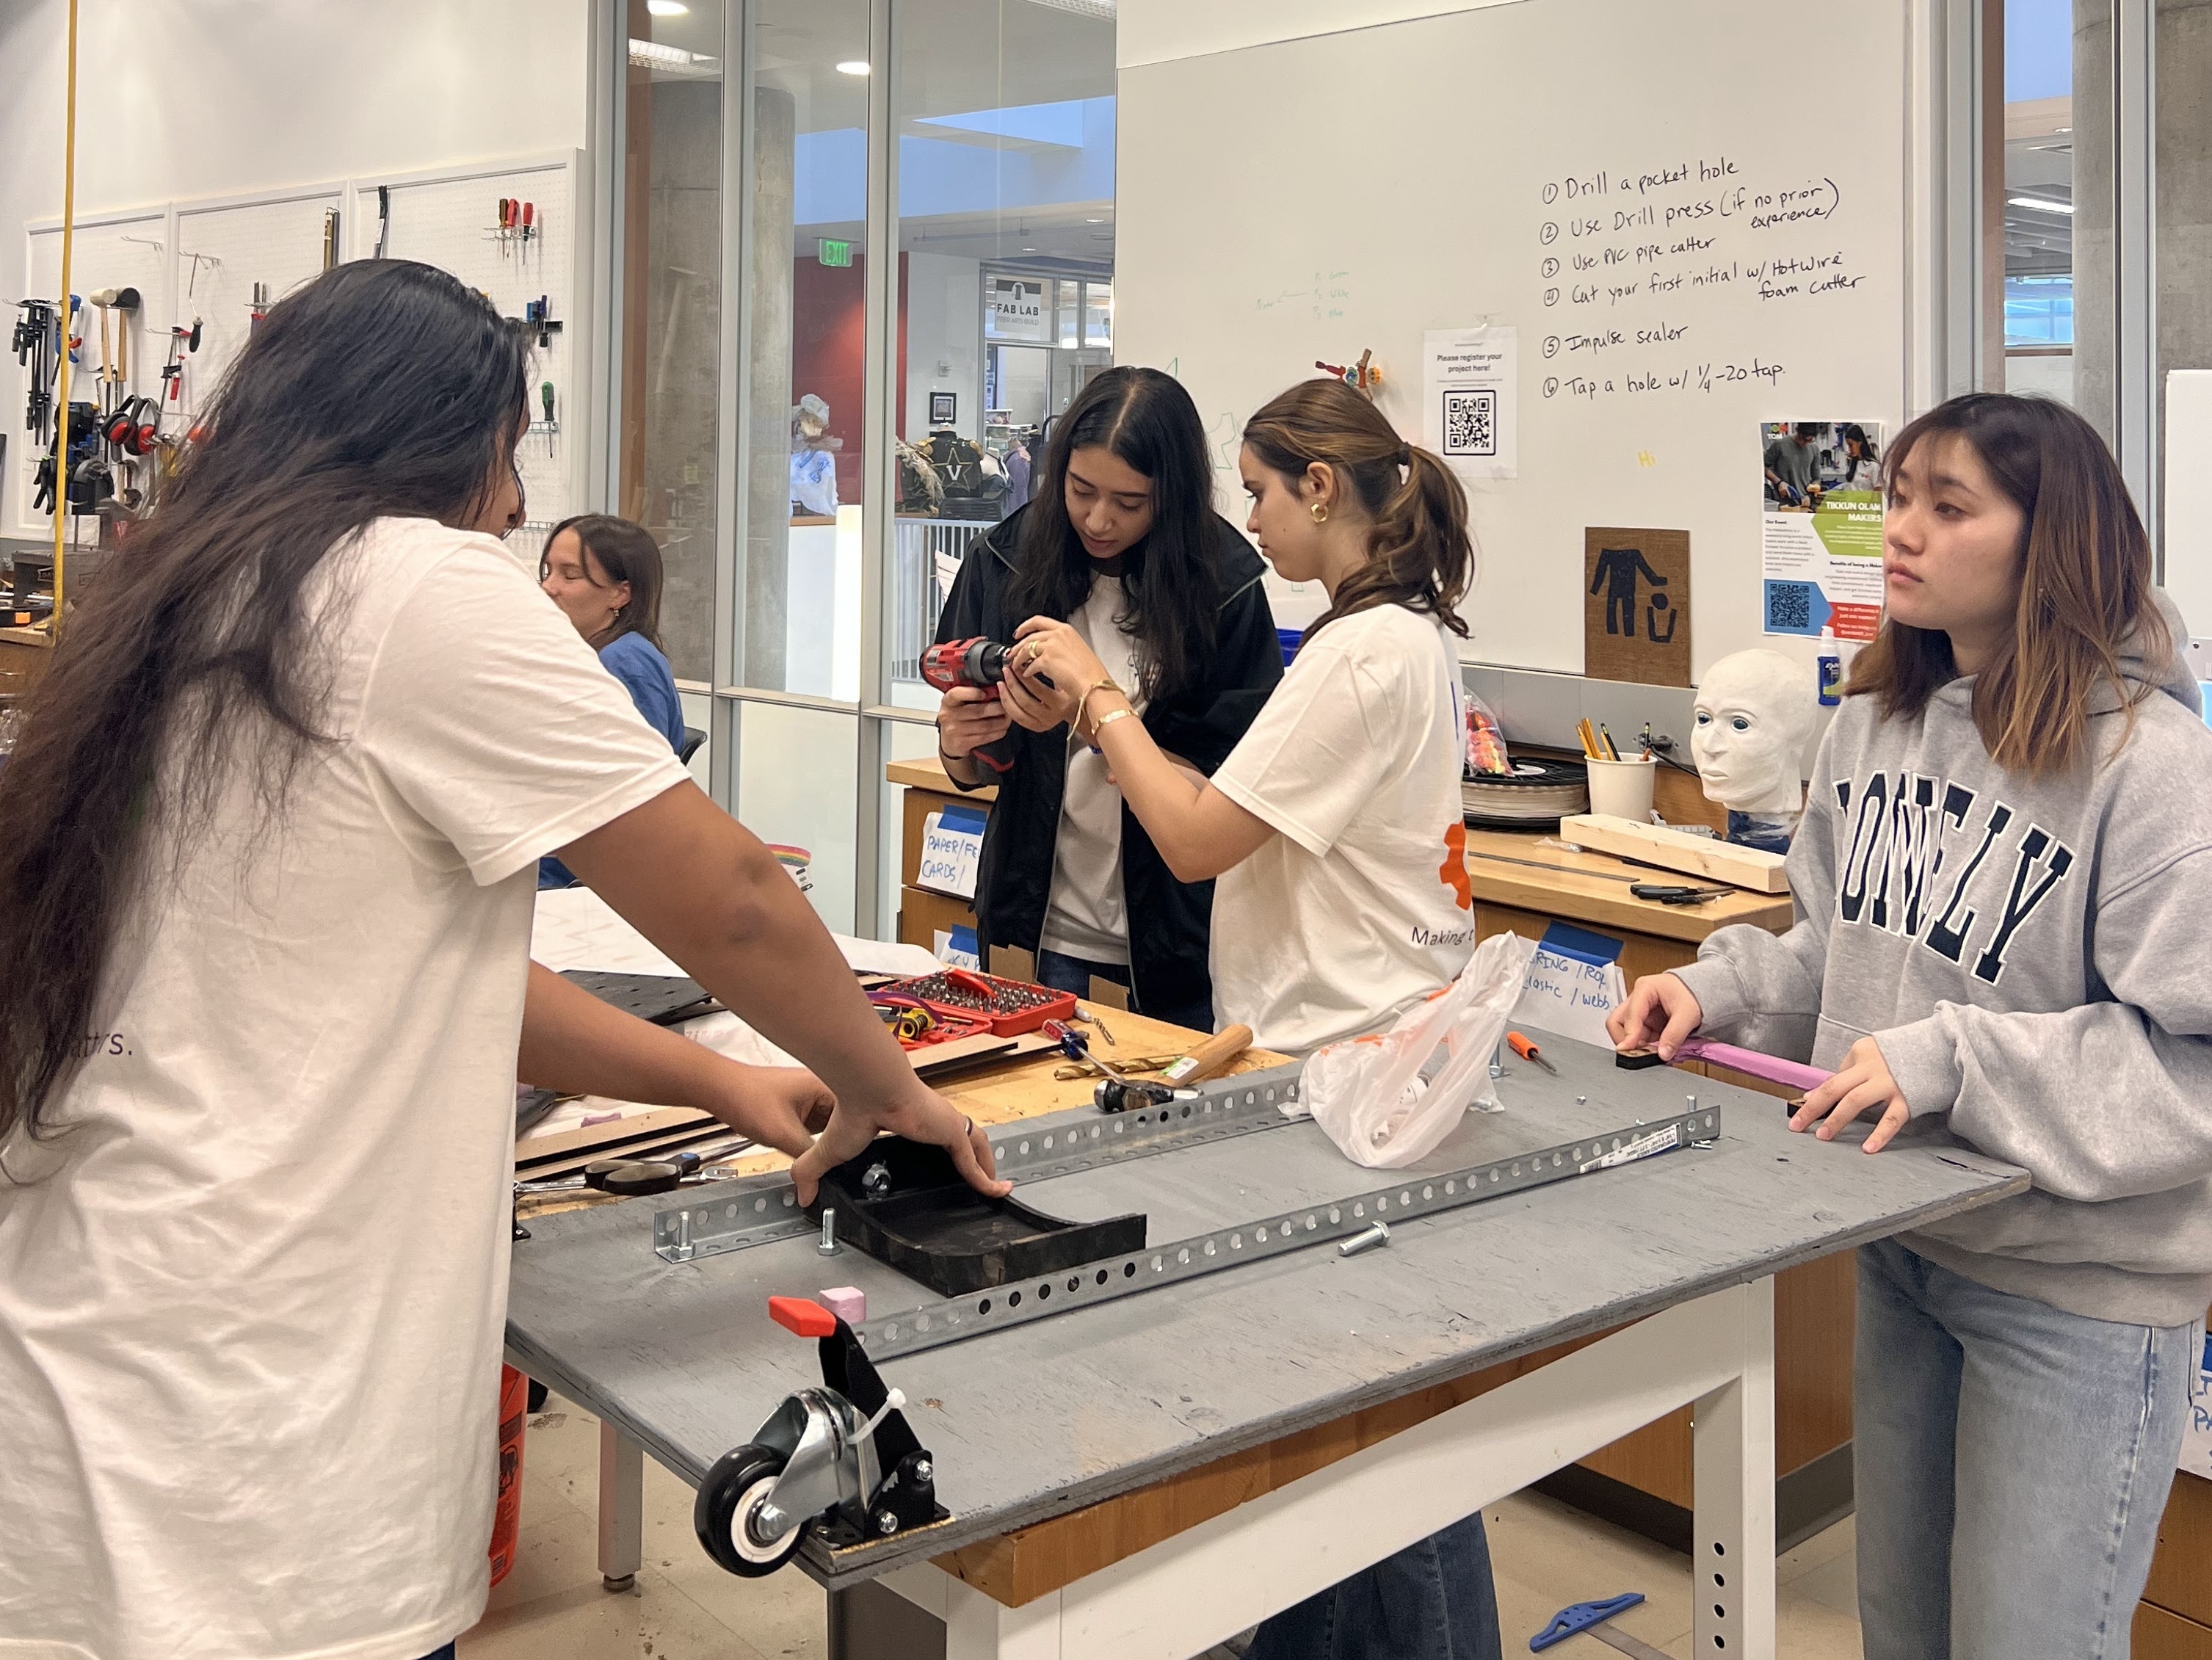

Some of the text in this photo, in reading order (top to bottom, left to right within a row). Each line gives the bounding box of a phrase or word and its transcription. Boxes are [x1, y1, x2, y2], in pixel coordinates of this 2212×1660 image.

[1565, 172, 1608, 199] Drill
[1620, 179, 1632, 191] a
[1639, 163, 1689, 195] pocket
[1699, 157, 1739, 183] hole
[1571, 219, 1601, 238] Use
[1614, 206, 1653, 231] Drill
[1665, 201, 1714, 228] press
[1754, 192, 1772, 208] no
[1779, 179, 1823, 209] prior
[826, 241, 849, 264] EXIT
[1573, 255, 1599, 271] Use
[1636, 243, 1664, 264] pipe
[1573, 284, 1599, 303] Cut
[1609, 280, 1638, 305] your
[1649, 274, 1683, 294] first
[1689, 263, 1737, 286] initial
[1747, 260, 1767, 280] w/
[1758, 283, 1799, 301] foam
[997, 303, 1039, 316] FAB LAB
[1565, 330, 1625, 355] Impulse
[1637, 322, 1688, 344] sealer
[1460, 354, 1485, 363] register
[1487, 353, 1503, 362] your
[1448, 364, 1490, 373] project here!
[1564, 378, 1596, 399] Tap
[1604, 380, 1614, 392] a
[1627, 372, 1661, 392] hole
[1669, 371, 1687, 389] w/
[946, 465, 962, 481] V
[1826, 501, 1882, 511] TIKKUN OLAM
[1848, 513, 1882, 523] MAKERS
[1412, 927, 1467, 946] Making
